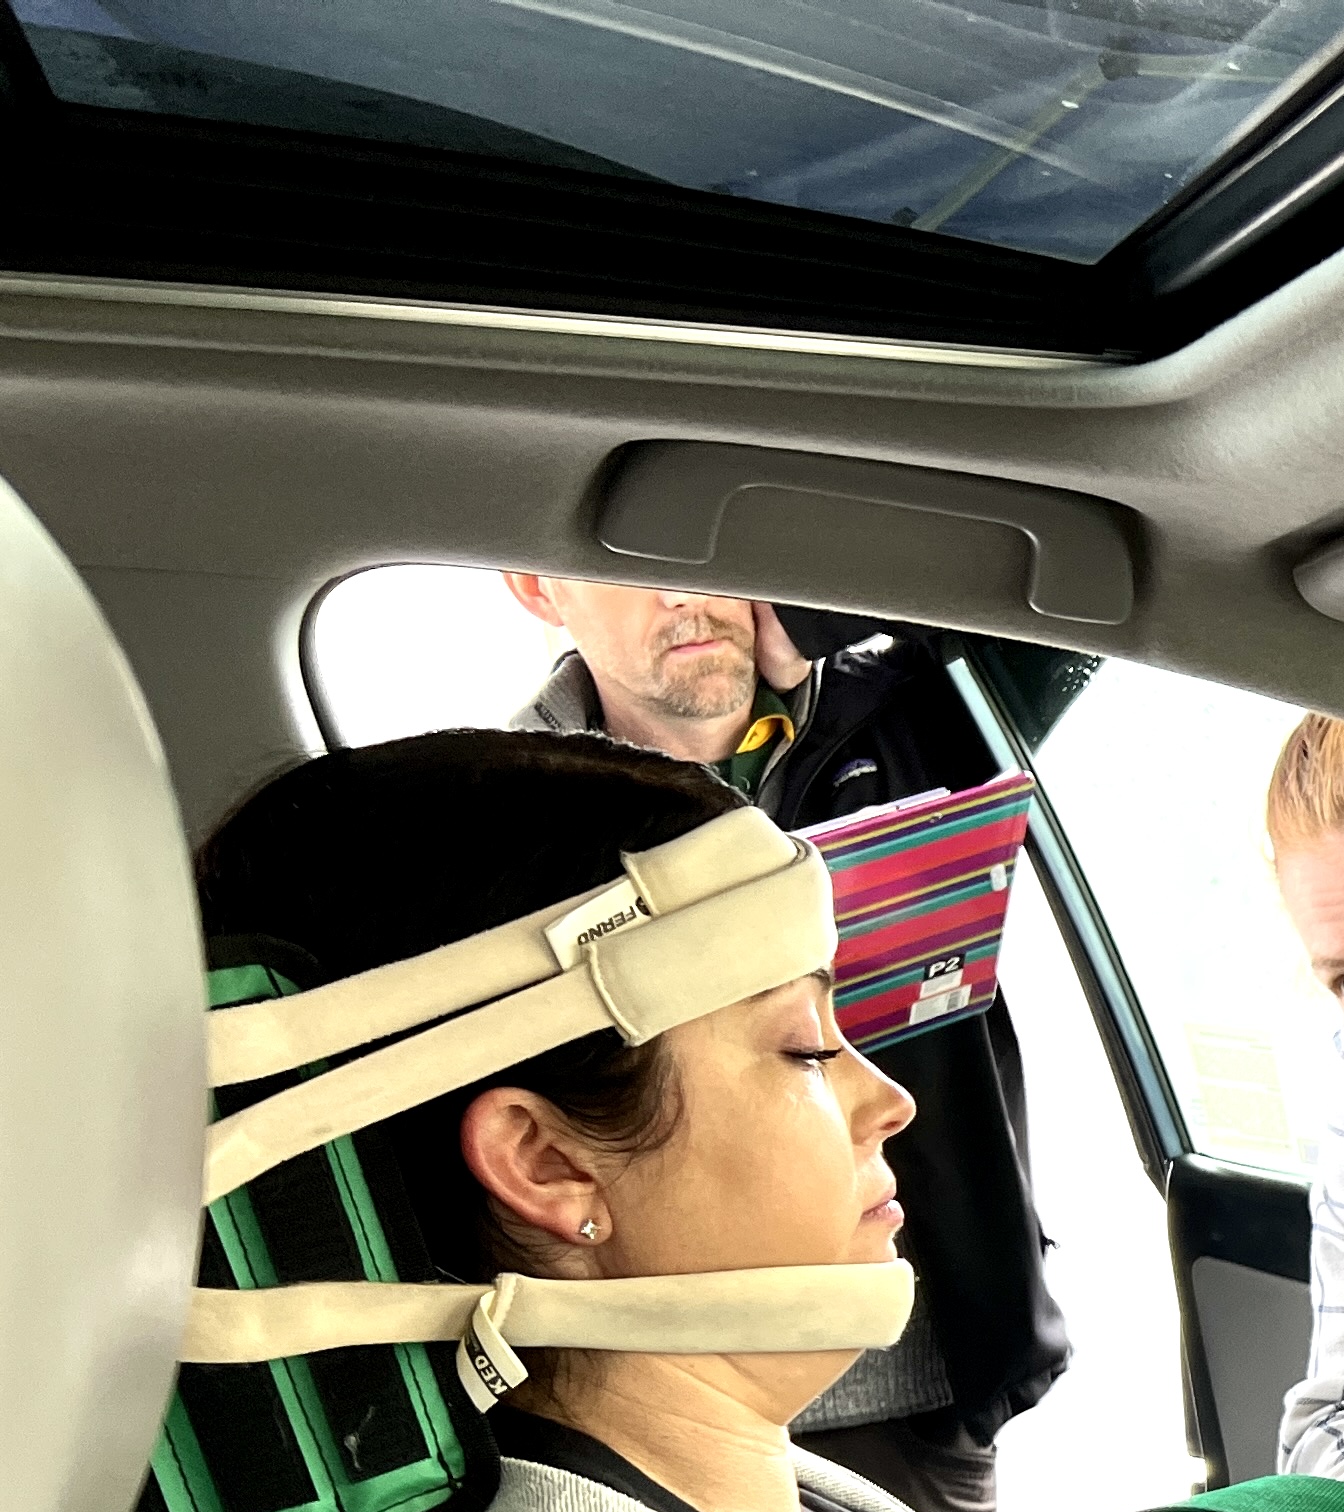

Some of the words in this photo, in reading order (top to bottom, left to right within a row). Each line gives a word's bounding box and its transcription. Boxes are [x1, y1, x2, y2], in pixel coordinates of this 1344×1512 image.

[576, 905, 638, 946] FERNO
[928, 956, 961, 978] P2
[474, 1354, 508, 1395] KED
